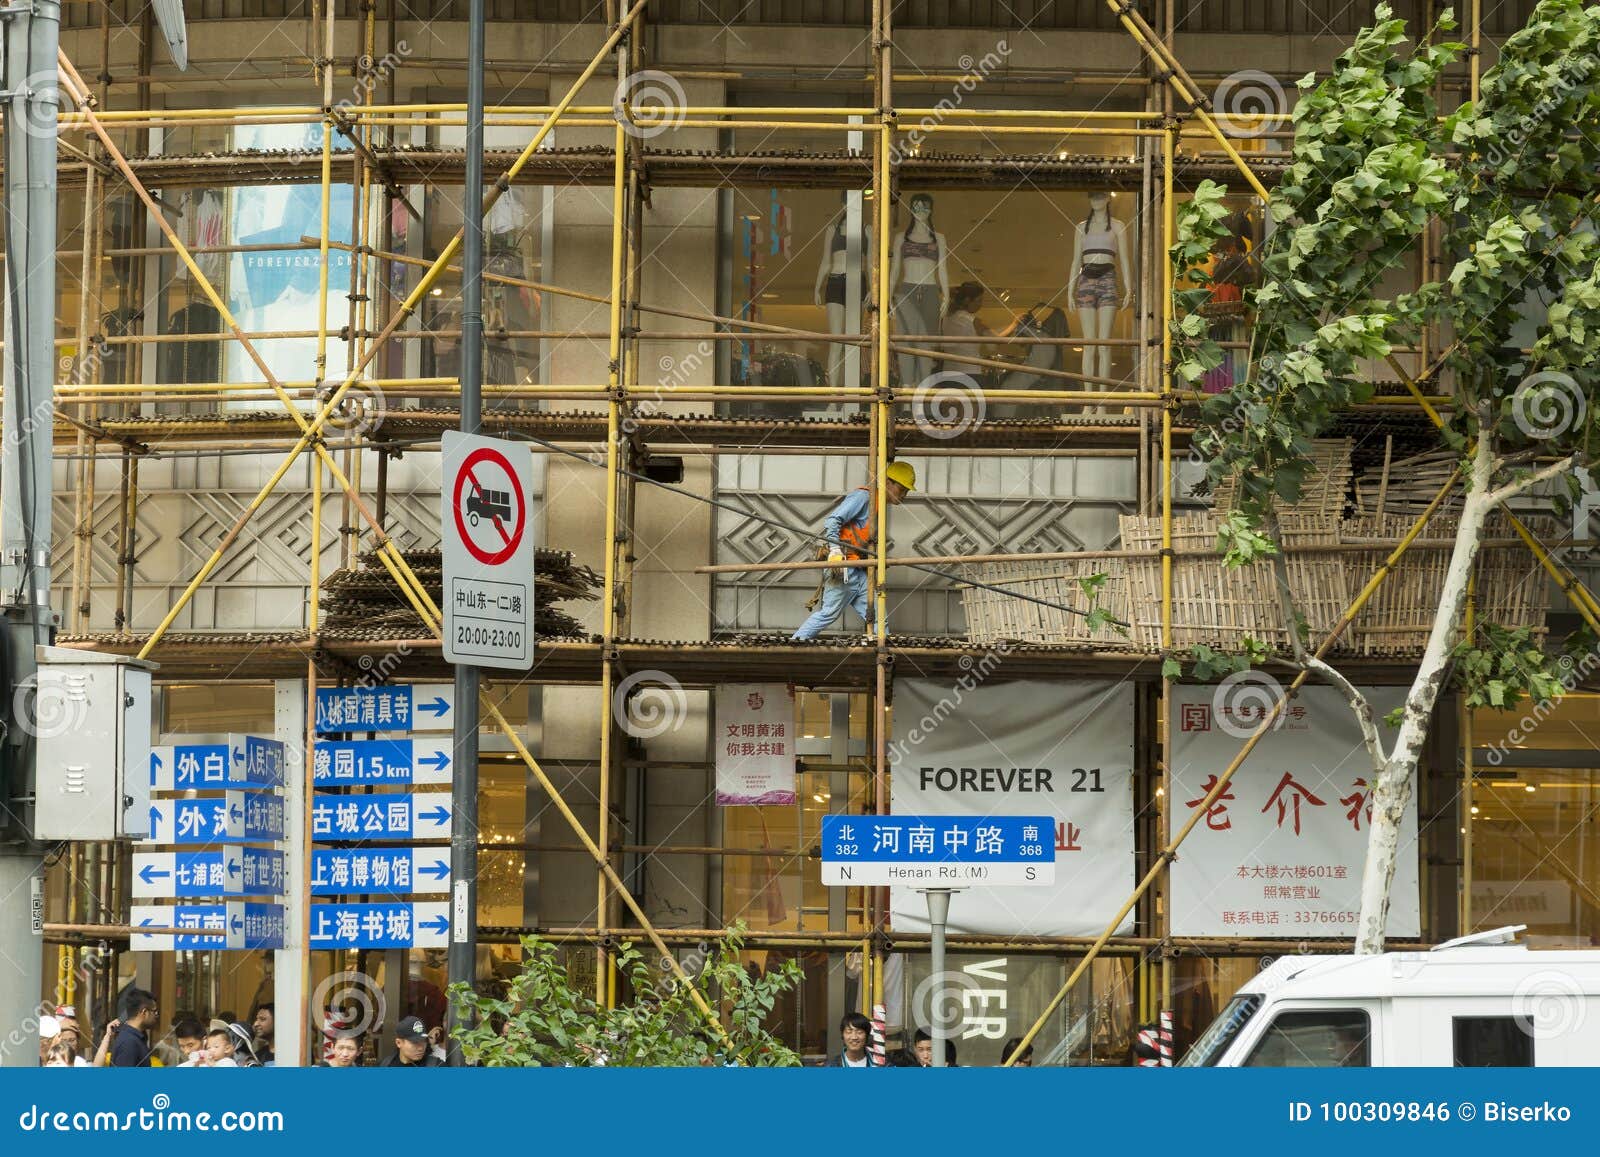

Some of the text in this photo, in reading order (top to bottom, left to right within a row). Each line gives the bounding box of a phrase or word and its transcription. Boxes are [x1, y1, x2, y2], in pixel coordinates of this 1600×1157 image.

[248, 256, 352, 267] FOREVER2.CN
[458, 626, 520, 648] 20:00-23:00
[315, 693, 409, 725] 小桃园清真寺
[726, 724, 785, 738] 文明黄浦
[726, 742, 785, 756] 你我共建
[178, 752, 231, 783] 外白
[247, 744, 283, 779] 人民广场
[920, 768, 1105, 792] FOREVER 21
[312, 802, 409, 833] 古城公园
[839, 825, 856, 841] 北
[873, 824, 1004, 855] 河南中路
[1023, 825, 1038, 842] 南
[835, 845, 858, 856] 382
[1019, 845, 1042, 856] 368
[176, 863, 224, 886] 七浦路
[244, 854, 283, 888] 新世界
[311, 856, 410, 887] 上海博物馆
[840, 867, 852, 880] N
[889, 866, 932, 878] Henan
[1025, 867, 1036, 880] S
[1237, 865, 1348, 879] 本大楼六楼601室
[1264, 885, 1321, 899] 照常营业
[178, 912, 226, 943] 河南
[310, 910, 411, 942] 上海书城
[963, 958, 1007, 1040] VER
